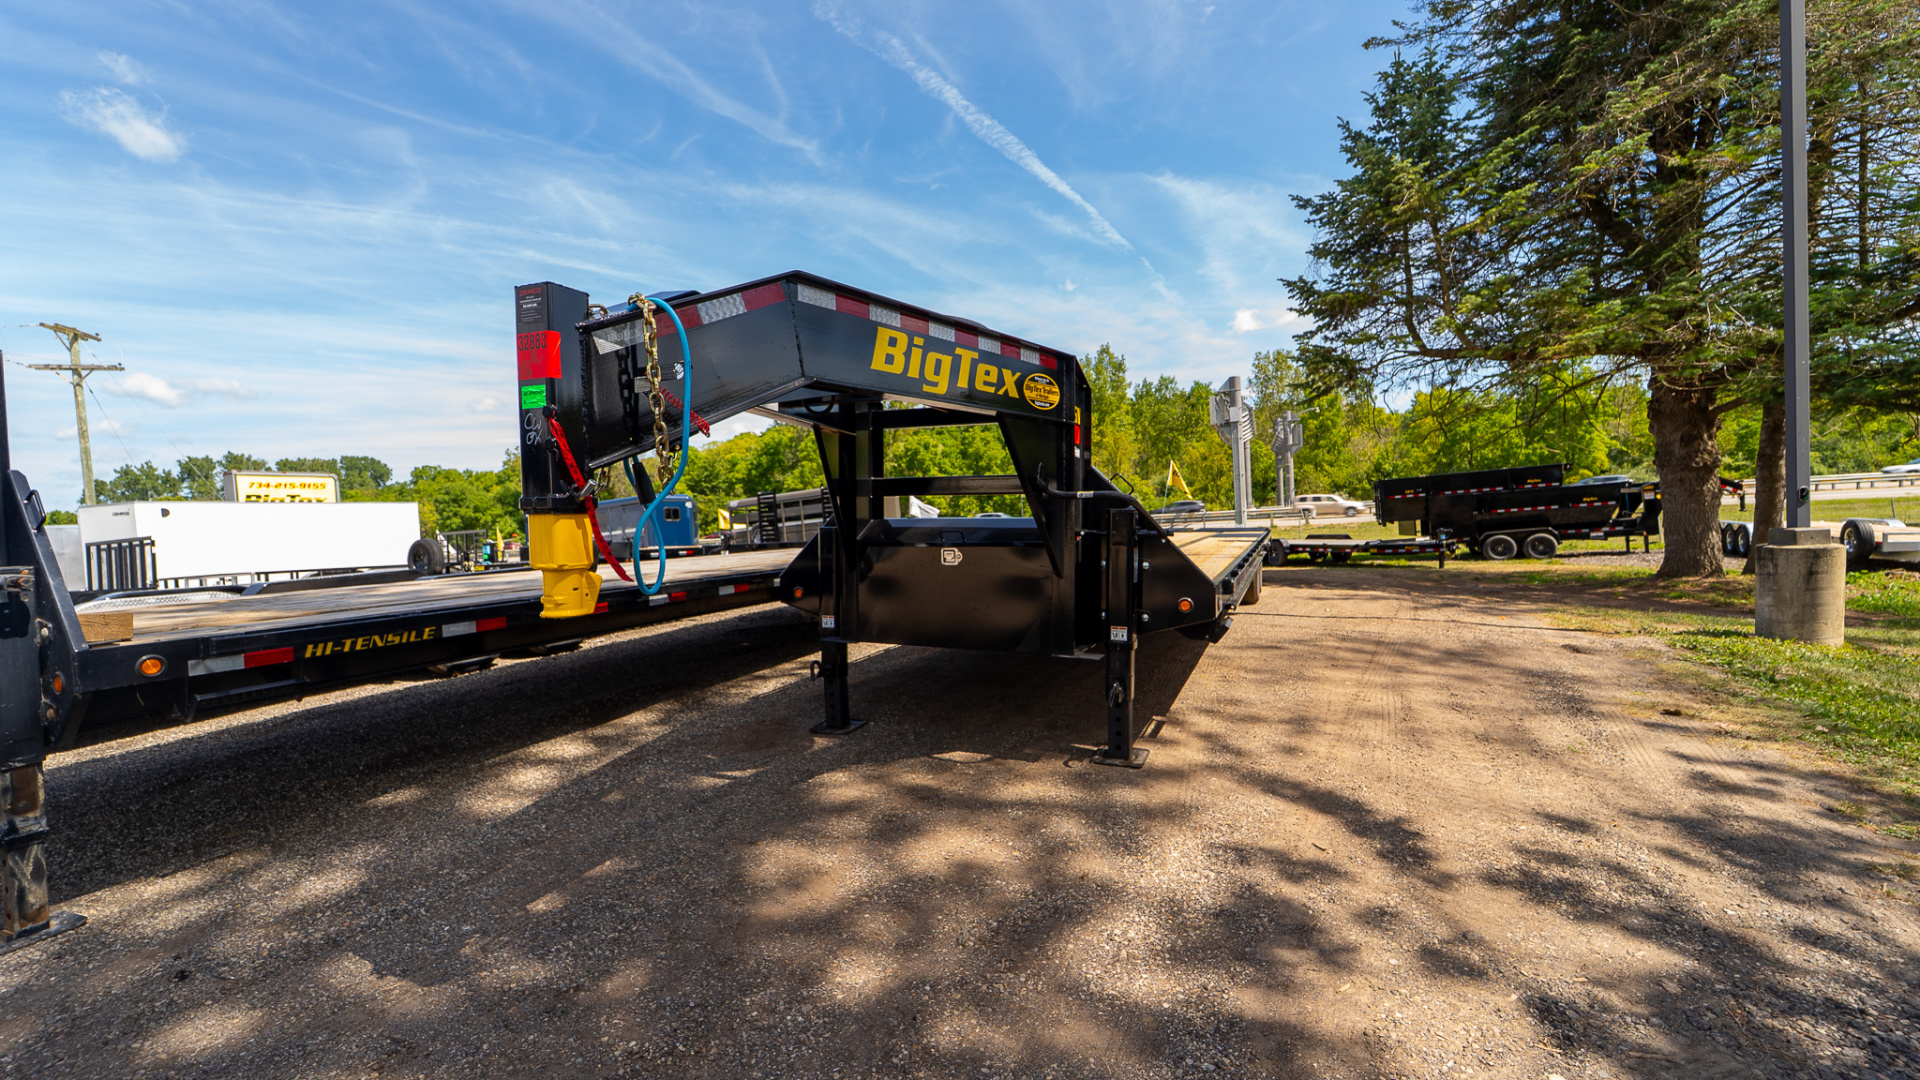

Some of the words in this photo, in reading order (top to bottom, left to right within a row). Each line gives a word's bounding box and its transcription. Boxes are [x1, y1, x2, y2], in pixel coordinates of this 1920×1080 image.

[518, 332, 547, 351] 32883
[870, 326, 1022, 399] BigTex
[304, 626, 437, 658] HI-TENSILE
